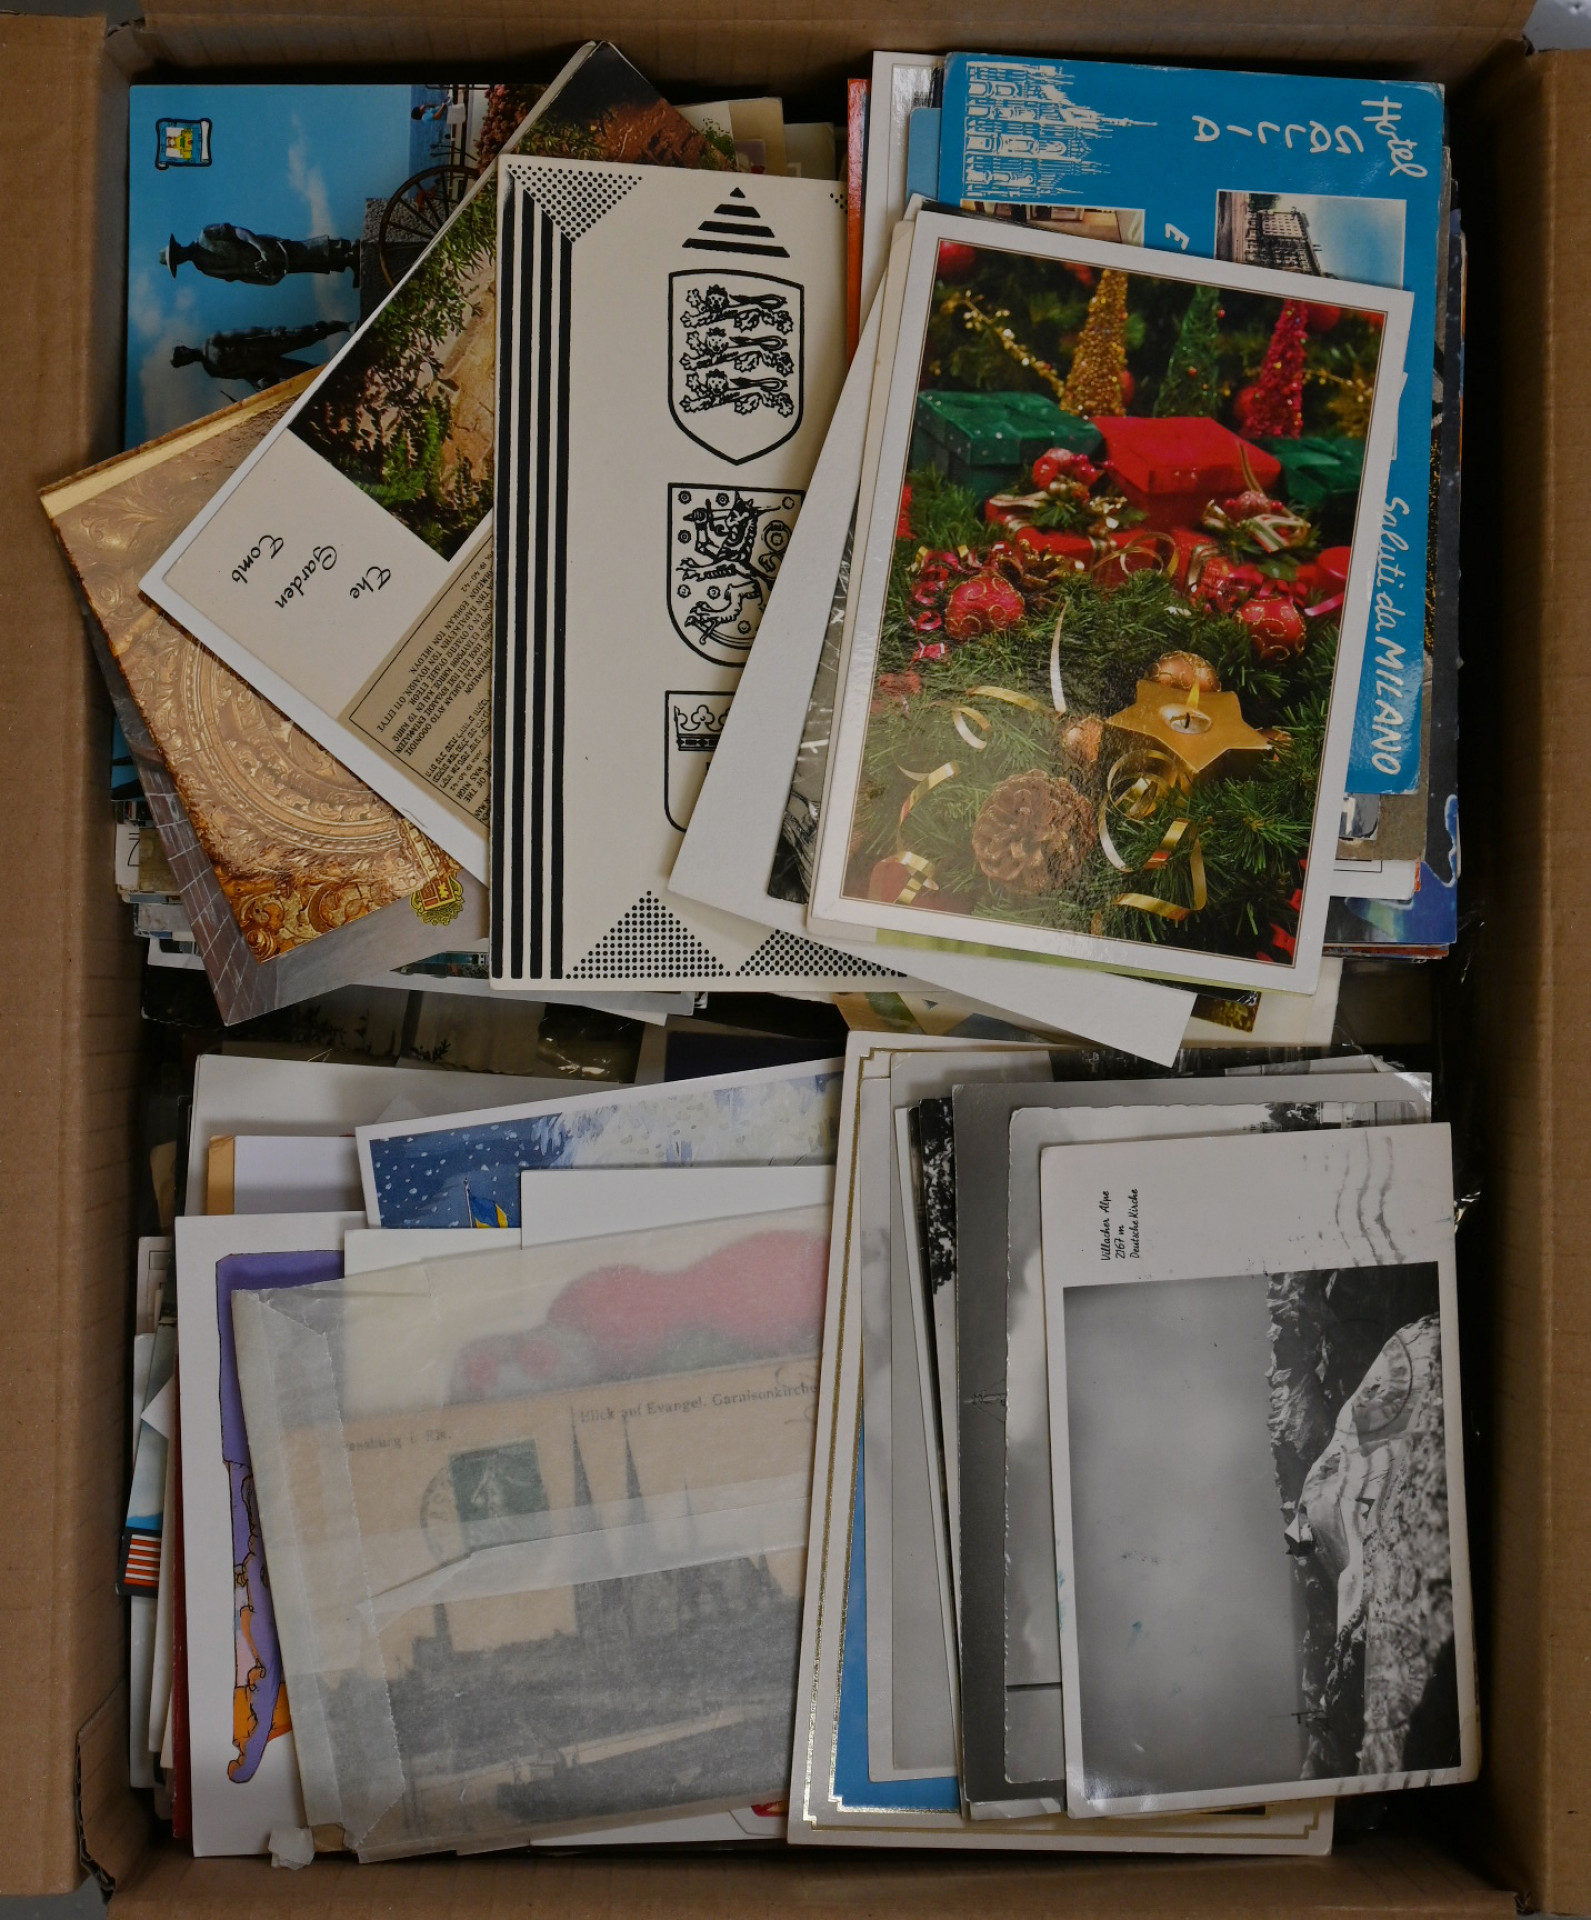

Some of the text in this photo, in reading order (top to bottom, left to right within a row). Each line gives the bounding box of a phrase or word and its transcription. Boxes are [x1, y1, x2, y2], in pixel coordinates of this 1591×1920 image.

[1361, 96, 1428, 177] Hotel
[231, 535, 283, 583] Tomb
[275, 545, 336, 607] Garden
[349, 566, 390, 598] The
[1370, 496, 1410, 776] Saluti da MILANO
[1128, 1188, 1139, 1219] Kirche
